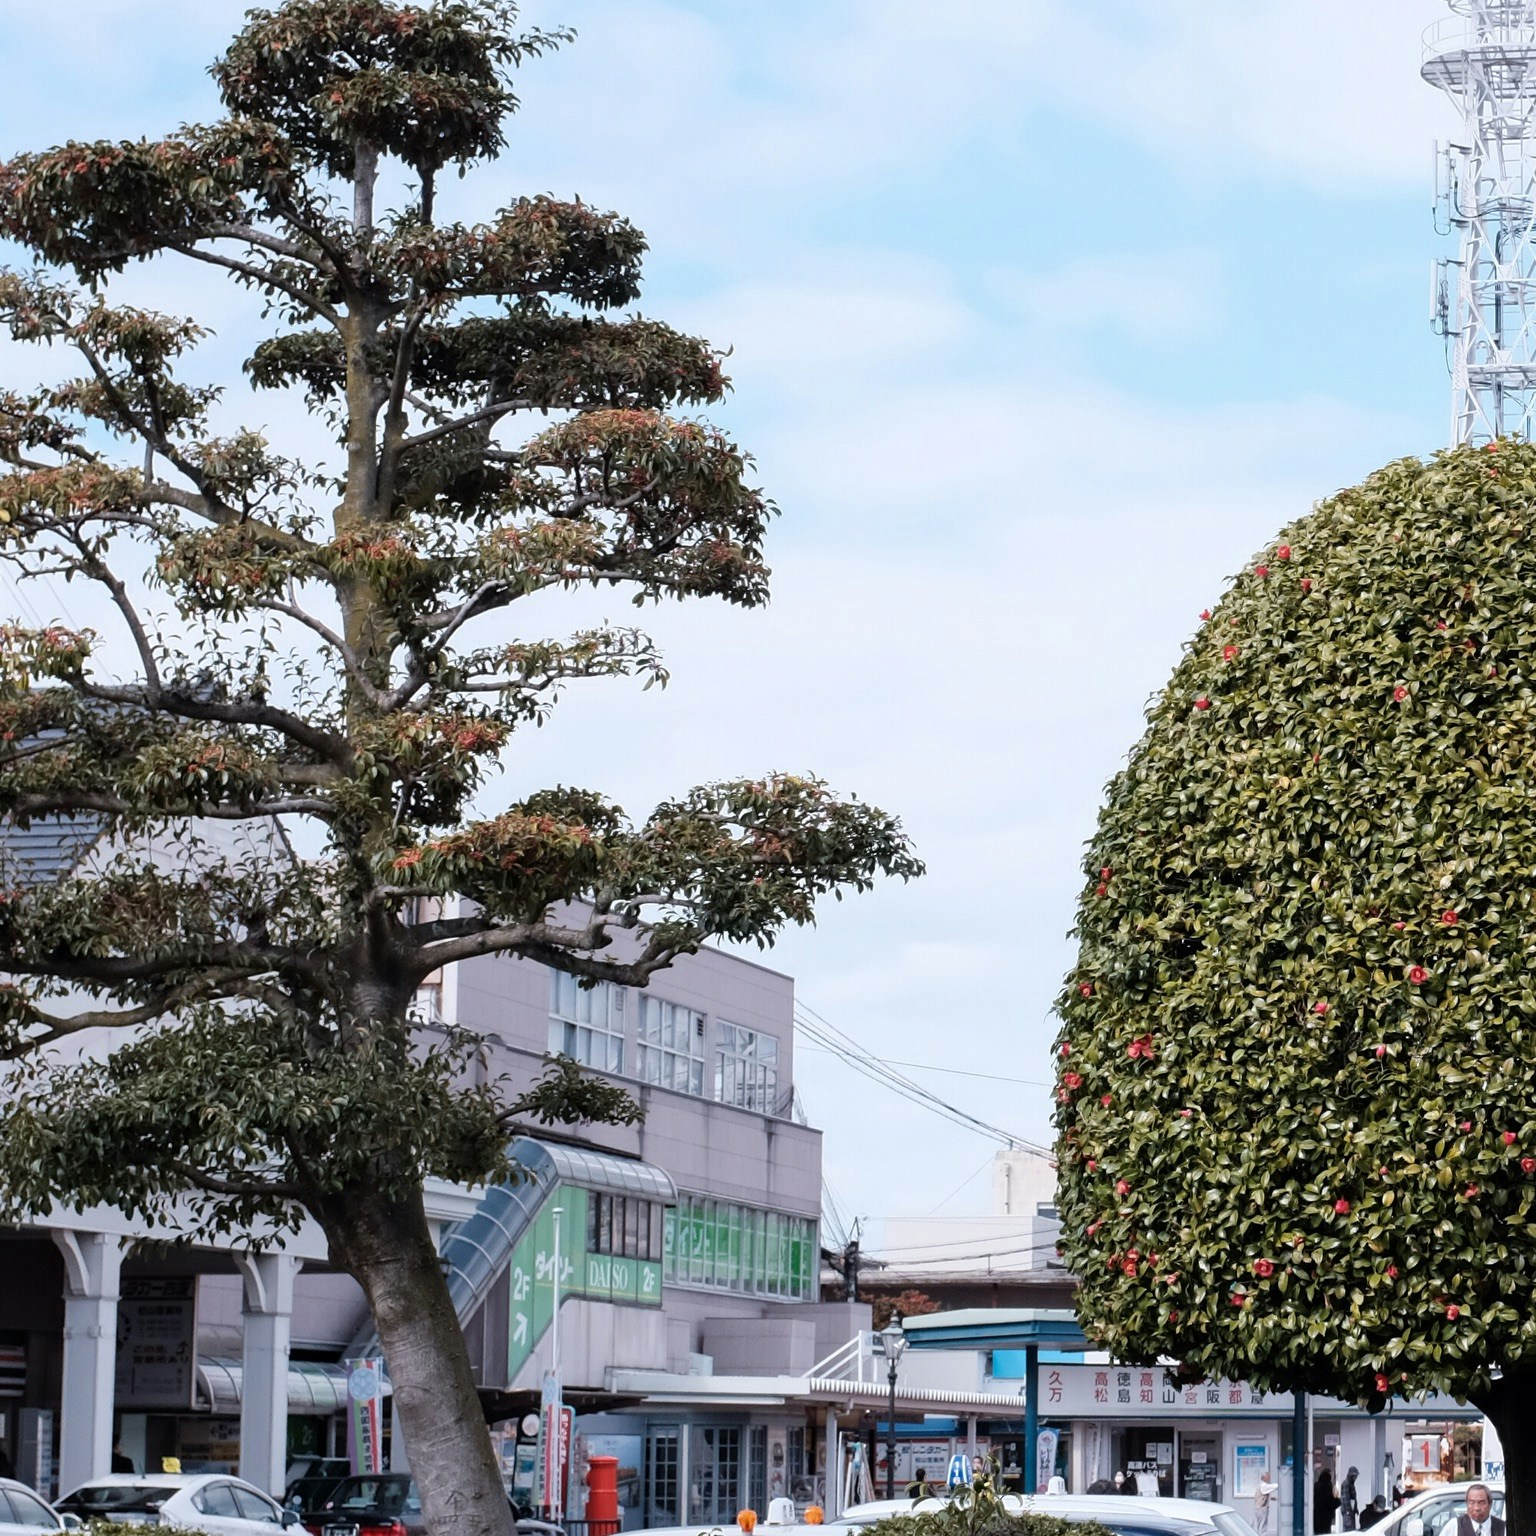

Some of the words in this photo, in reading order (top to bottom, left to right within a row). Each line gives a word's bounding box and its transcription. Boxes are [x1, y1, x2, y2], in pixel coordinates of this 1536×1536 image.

[513, 1266, 531, 1301] 2F
[589, 1261, 629, 1289] DAISO
[643, 1266, 656, 1293] 2F
[1048, 1370, 1063, 1403] 久万
[1094, 1371, 1109, 1403] 高松
[1117, 1372, 1131, 1404] 徳島
[1140, 1372, 1154, 1404] 高知
[1421, 1440, 1431, 1468] 1
